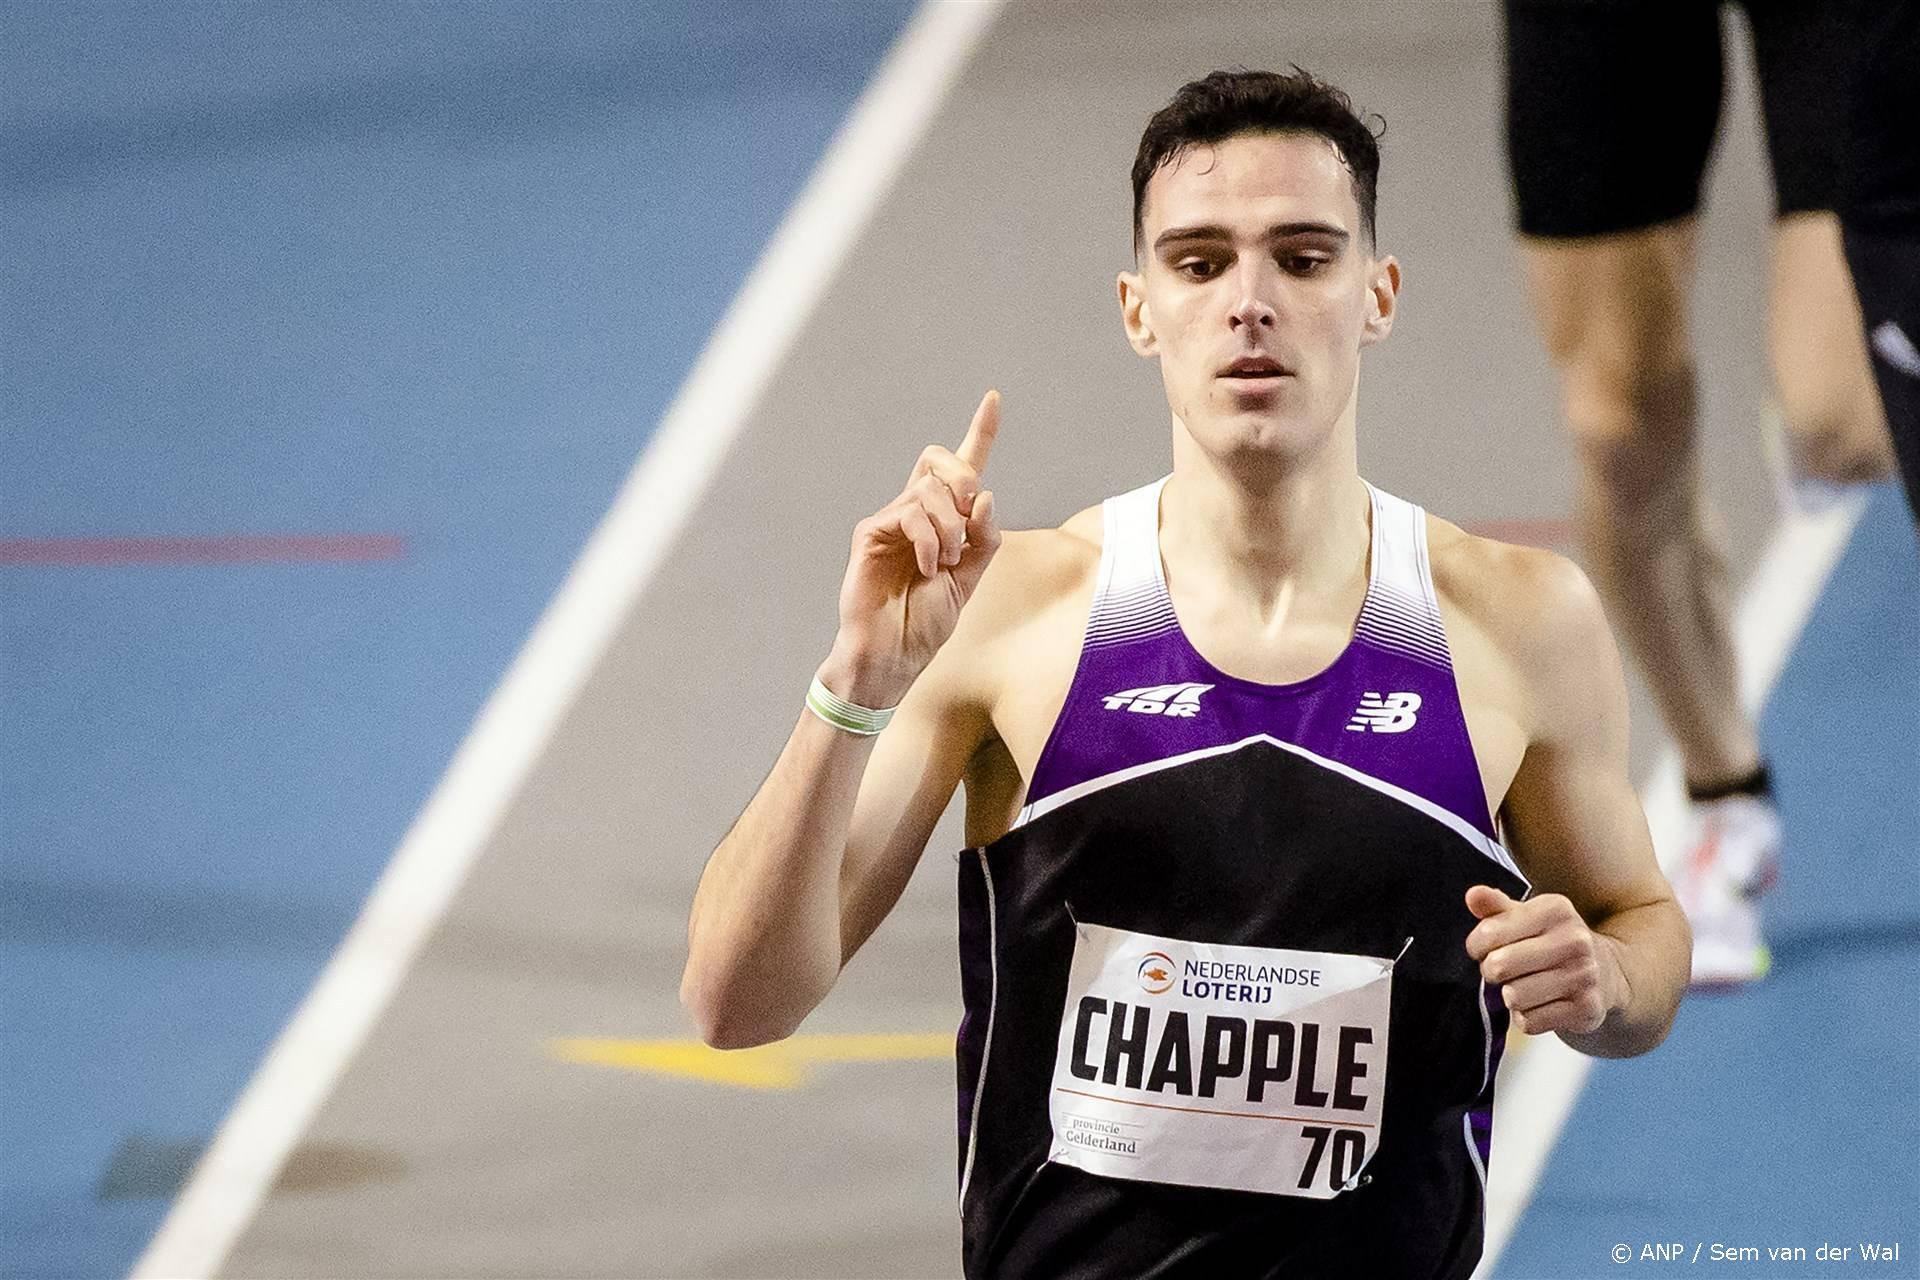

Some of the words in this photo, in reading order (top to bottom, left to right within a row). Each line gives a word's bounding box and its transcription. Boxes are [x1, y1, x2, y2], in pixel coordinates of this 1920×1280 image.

[1184, 959, 1321, 988] NEDERLANDSE
[1182, 980, 1273, 1004] LOTERIJ
[1070, 995, 1375, 1112] CHAPPLE
[1072, 1117, 1121, 1136] provincie
[1065, 1130, 1137, 1154] Gelderland
[1297, 1126, 1367, 1191] 70
